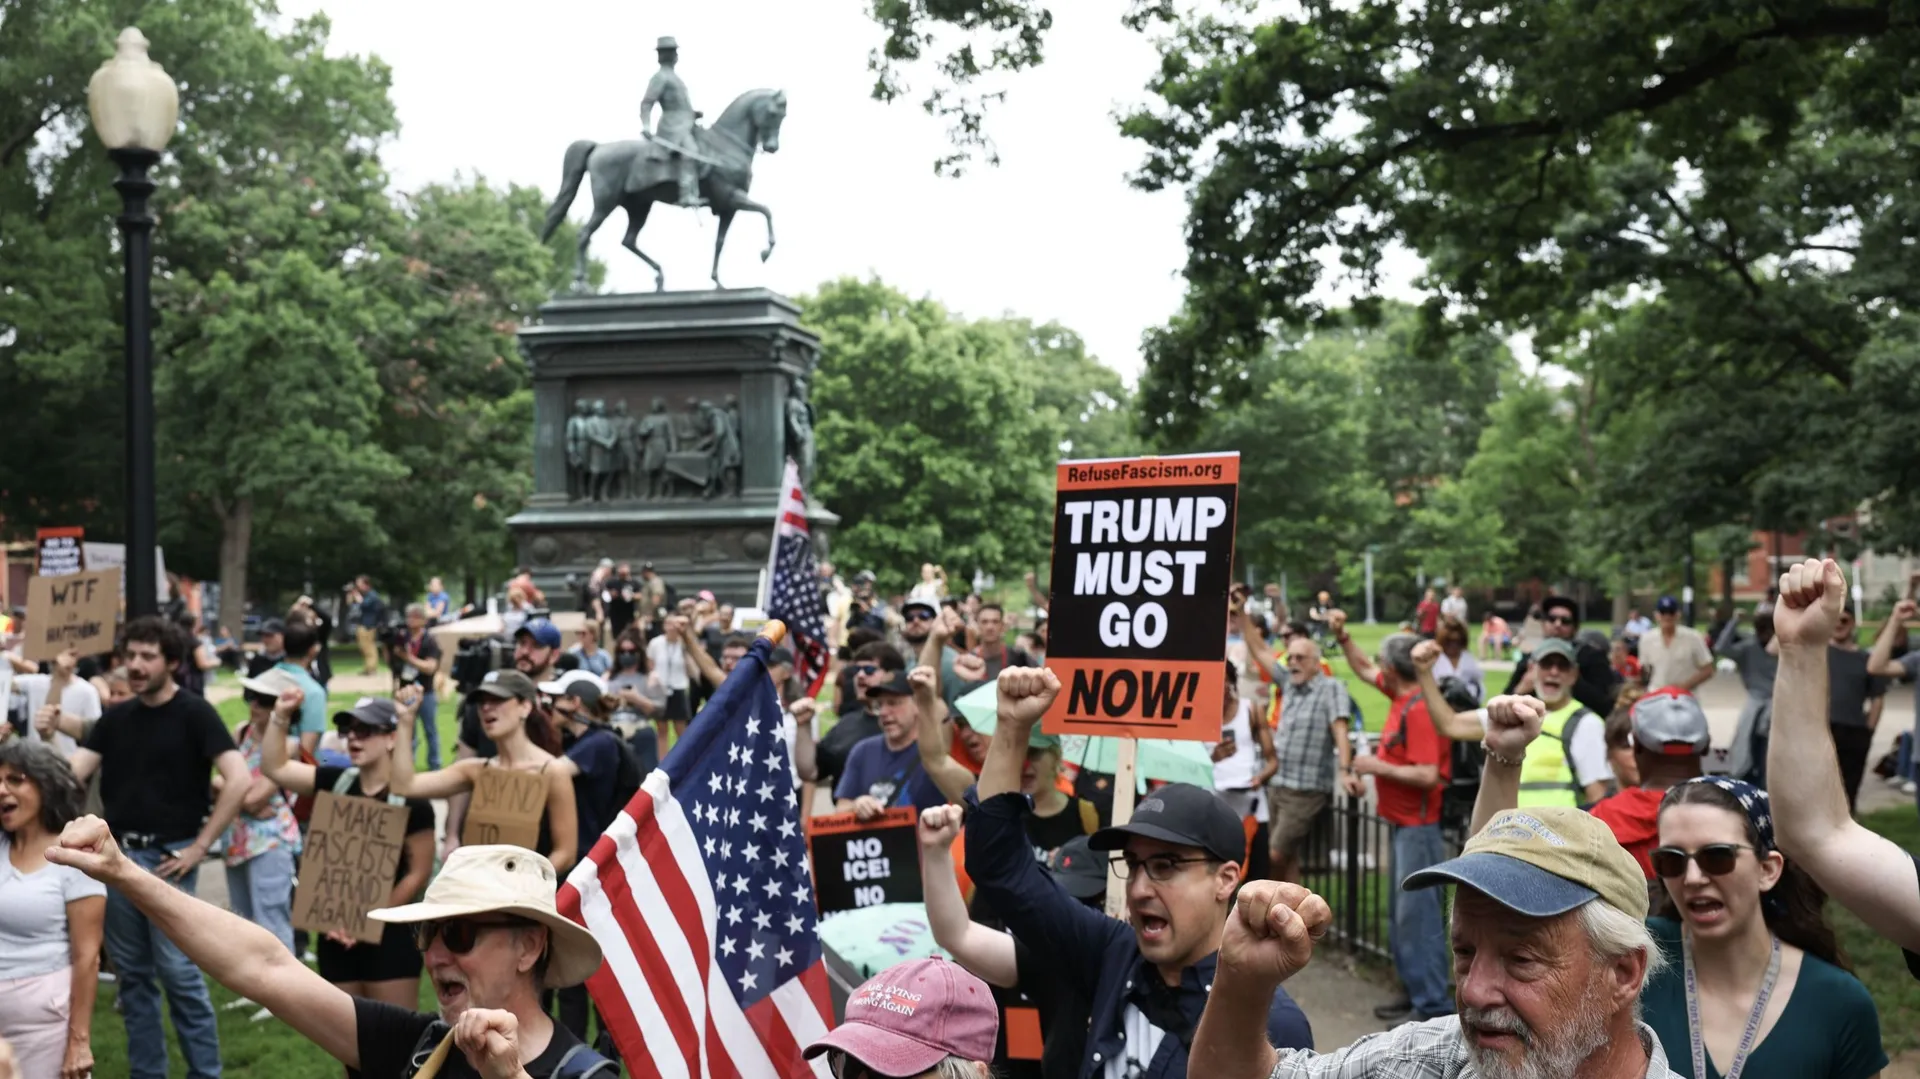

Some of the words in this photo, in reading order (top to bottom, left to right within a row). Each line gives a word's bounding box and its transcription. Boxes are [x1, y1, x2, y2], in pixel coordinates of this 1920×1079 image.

[1068, 462, 1222, 482] RefuseFascism.org
[1064, 496, 1227, 544] TRUMP
[1073, 549, 1207, 596] MUST
[51, 579, 99, 606] WTF
[1098, 601, 1168, 649] GO
[1067, 669, 1200, 720] NOW!
[475, 770, 512, 811] SAY
[508, 776, 543, 814] NO
[330, 800, 393, 839] MAKE
[477, 822, 500, 845] TO
[1516, 813, 1566, 846] SPRINGS
[306, 829, 400, 881] FASCISTS
[846, 837, 883, 860] NO
[314, 866, 382, 905] AFRAID
[843, 857, 891, 882] ICE!
[854, 885, 886, 907] NO
[306, 893, 369, 934] AGAIN
[885, 984, 922, 1002] LYING
[1687, 969, 1696, 994] NEW
[879, 999, 915, 1017] AGAIN
[1691, 999, 1700, 1026] YORK
[1728, 1053, 1745, 1079] YORK
[1740, 990, 1768, 1050] UNIVERSITY
